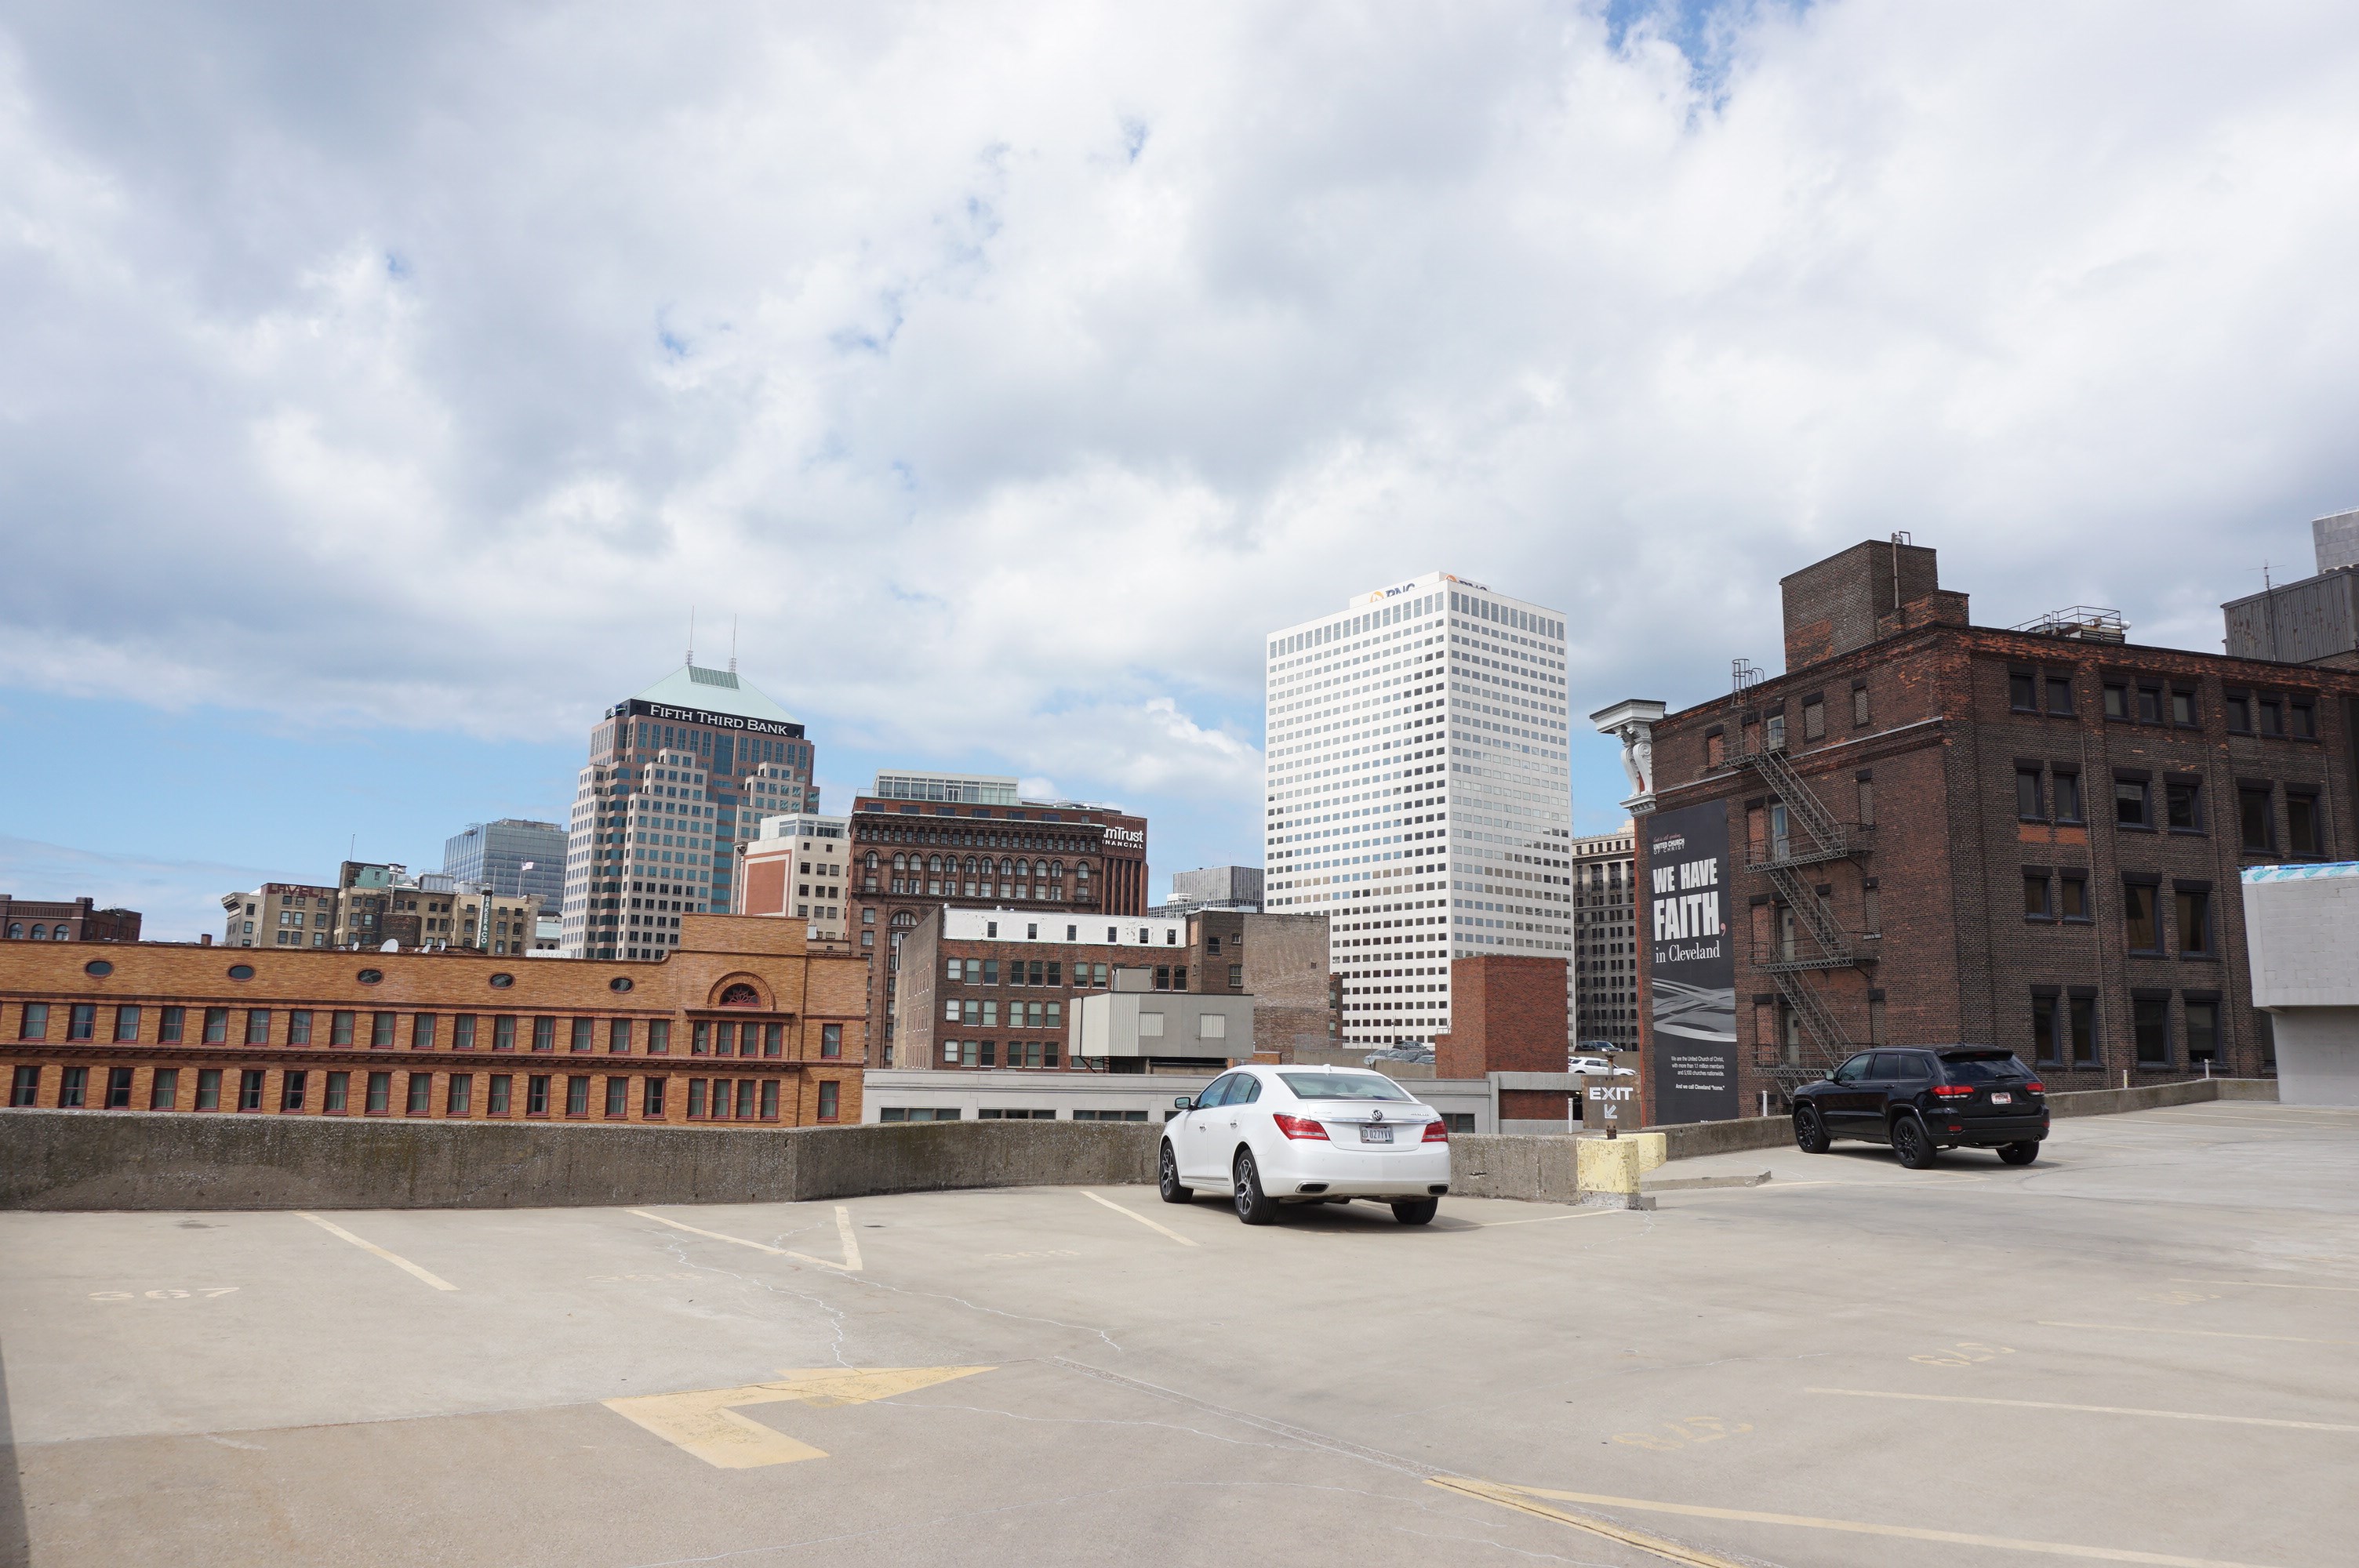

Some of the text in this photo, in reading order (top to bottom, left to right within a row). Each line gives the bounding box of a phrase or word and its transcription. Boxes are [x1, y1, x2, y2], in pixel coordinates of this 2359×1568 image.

[650, 704, 787, 735] FIFTH THIRD BANK
[1103, 826, 1144, 843] mTrust
[1653, 838, 1685, 851] UNITED CHURCH
[1663, 844, 1685, 853] CHRIST
[1652, 858, 1718, 894] WE HAVE
[1653, 891, 1727, 942] FAITH,
[1655, 940, 1721, 964] in Cleveland
[1589, 1087, 1634, 1101] EXIT
[87, 1287, 240, 1301] 367
